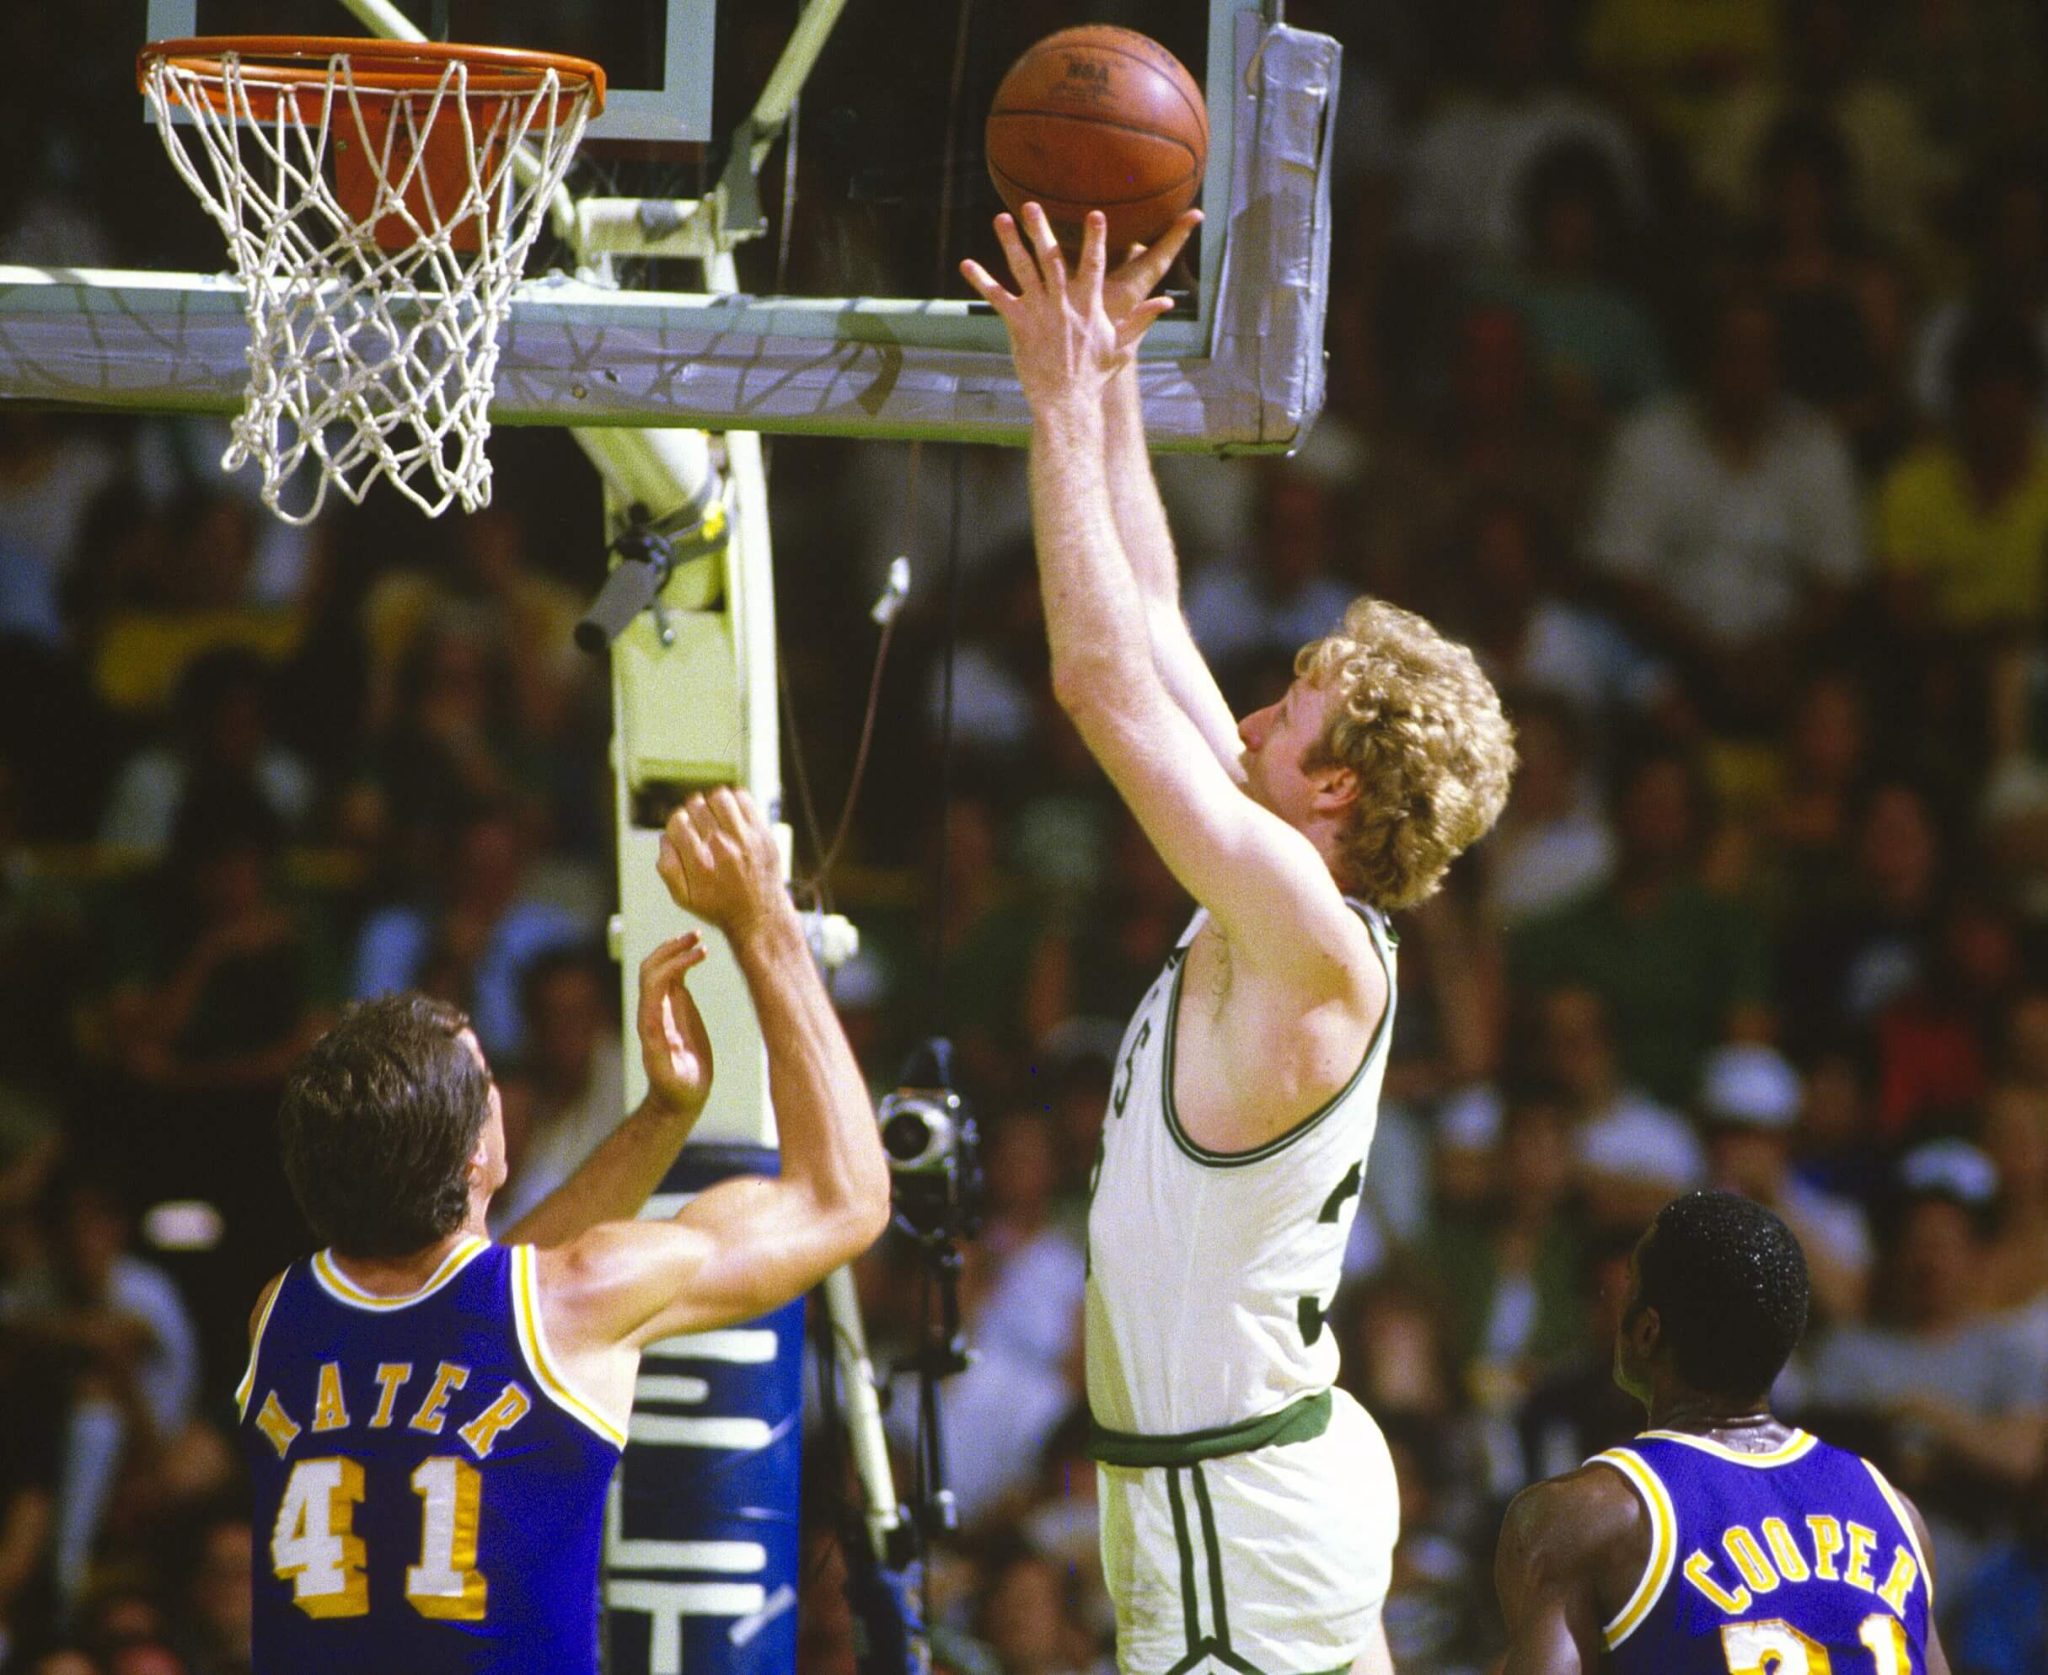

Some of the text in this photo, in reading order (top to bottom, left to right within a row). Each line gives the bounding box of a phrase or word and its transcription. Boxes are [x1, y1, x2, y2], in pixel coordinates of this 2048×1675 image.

[255, 1361, 532, 1459] NATER
[271, 1456, 488, 1621] 41
[1683, 1515, 1918, 1619] COOPER
